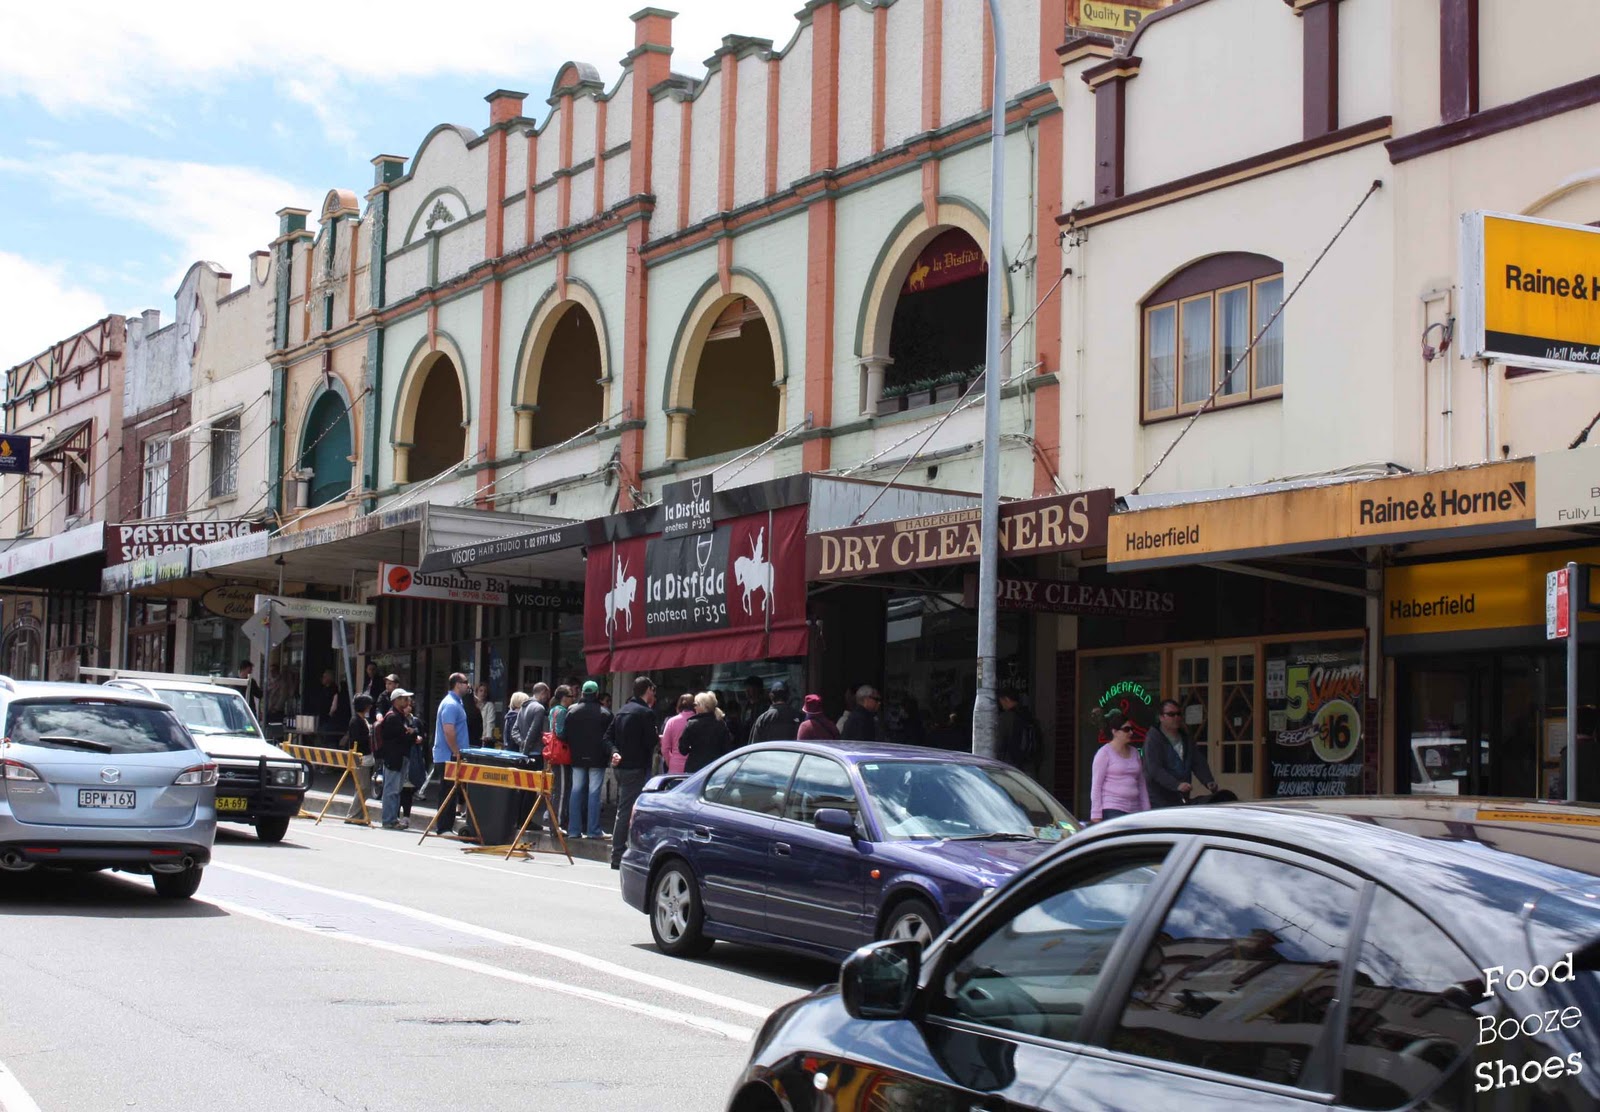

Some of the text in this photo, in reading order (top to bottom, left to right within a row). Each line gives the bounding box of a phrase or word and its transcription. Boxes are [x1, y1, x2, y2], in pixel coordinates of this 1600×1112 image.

[1083, 3, 1120, 26] Quality
[1505, 264, 1570, 298] Raine
[1545, 347, 1568, 360] We'll
[1569, 346, 1589, 361] look
[665, 500, 710, 522] la Disfida
[1360, 491, 1419, 525] Raine
[1440, 489, 1512, 515] Horne
[1558, 508, 1590, 521] Fully
[665, 523, 689, 533] enoteca
[905, 510, 982, 530] HABERFIELD
[119, 523, 251, 544] PASTICCERIA
[1126, 524, 1199, 551] Haberfield
[451, 548, 476, 564] visare
[478, 544, 495, 557] HAIR
[496, 539, 521, 553] STUDIO
[819, 535, 886, 575] DRY
[413, 569, 482, 592] Sunshine
[647, 568, 725, 603] la Disfida
[514, 593, 562, 607] visare
[1045, 583, 1175, 613] CLEANERS
[1389, 594, 1475, 619] Haberfield
[323, 606, 350, 615] eyecare
[351, 609, 374, 617] centre
[647, 608, 688, 624] enoteca
[1099, 681, 1152, 707] HABERFIELD
[1286, 666, 1310, 720] 5
[1277, 782, 1346, 795] BUSINESS SHIRTS
